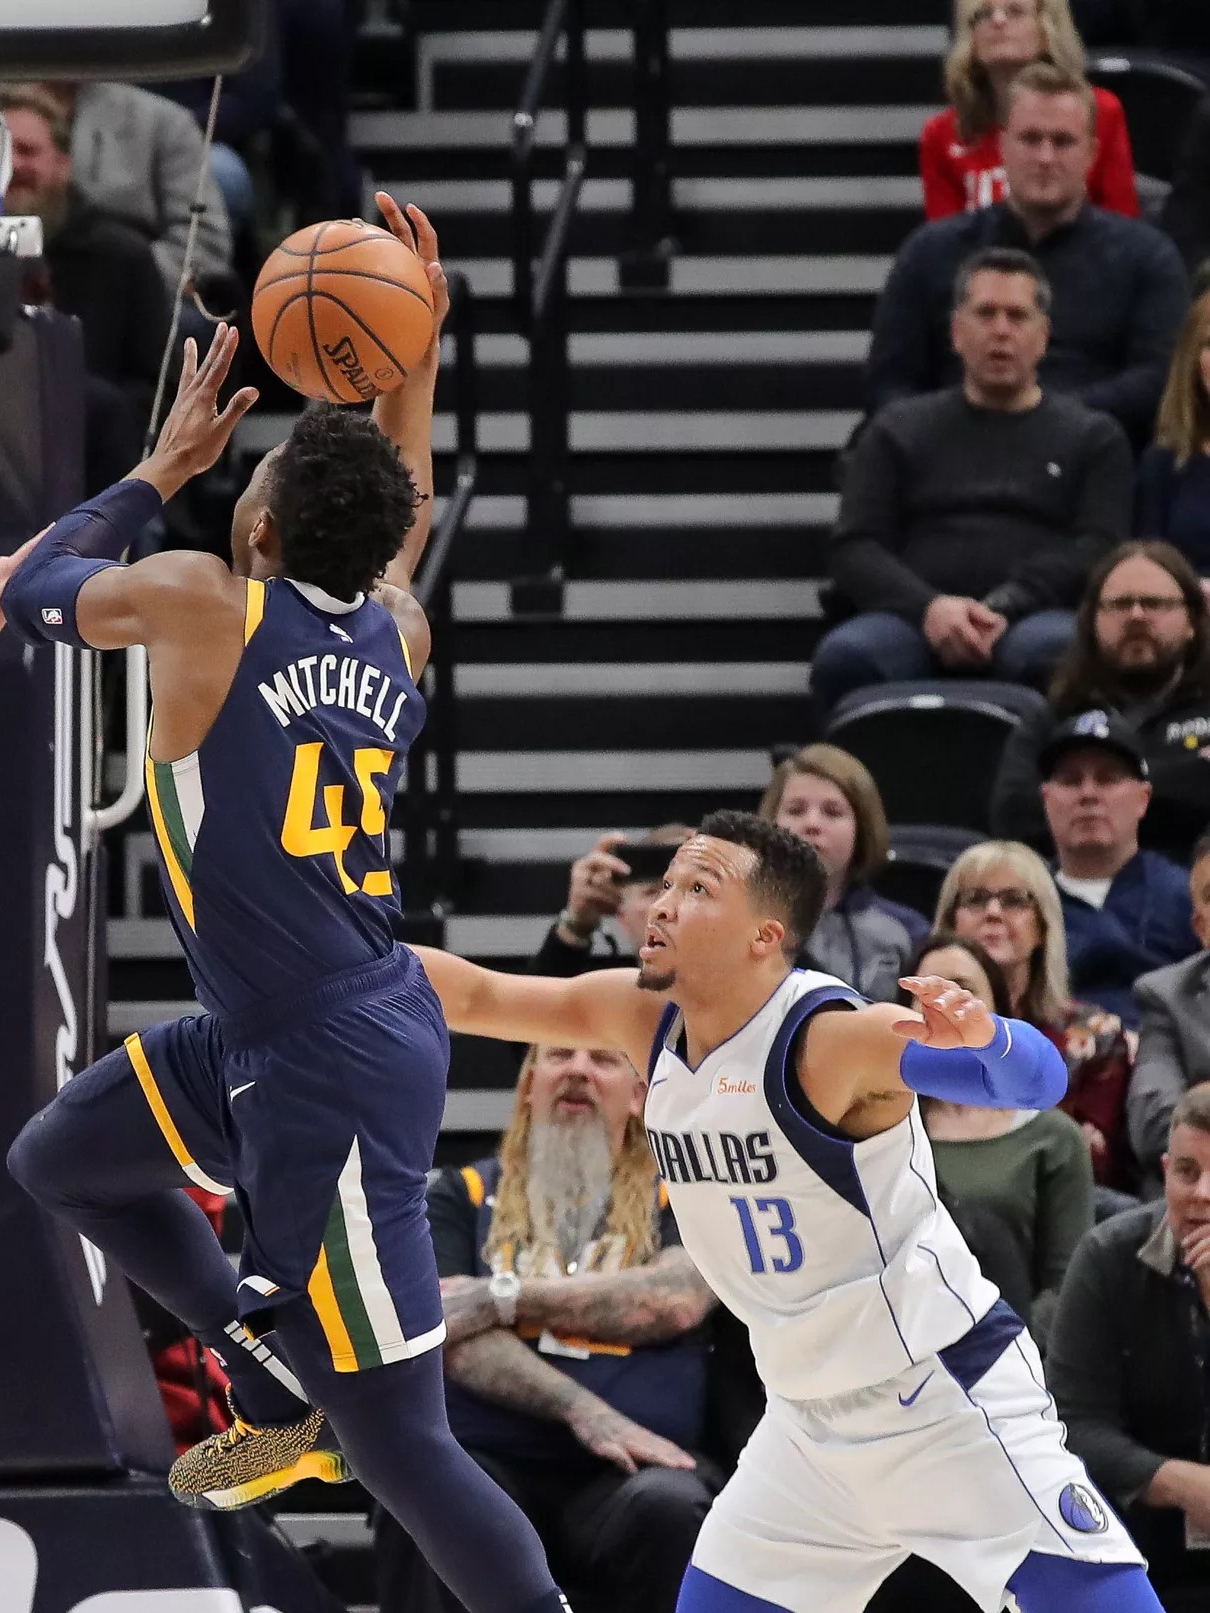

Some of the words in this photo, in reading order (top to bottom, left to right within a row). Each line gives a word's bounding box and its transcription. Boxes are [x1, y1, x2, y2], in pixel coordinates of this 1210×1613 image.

[257, 654, 408, 743] MITCHELL
[280, 742, 396, 898] 45
[718, 1077, 757, 1095] 5miles
[728, 1195, 806, 1275] 13
